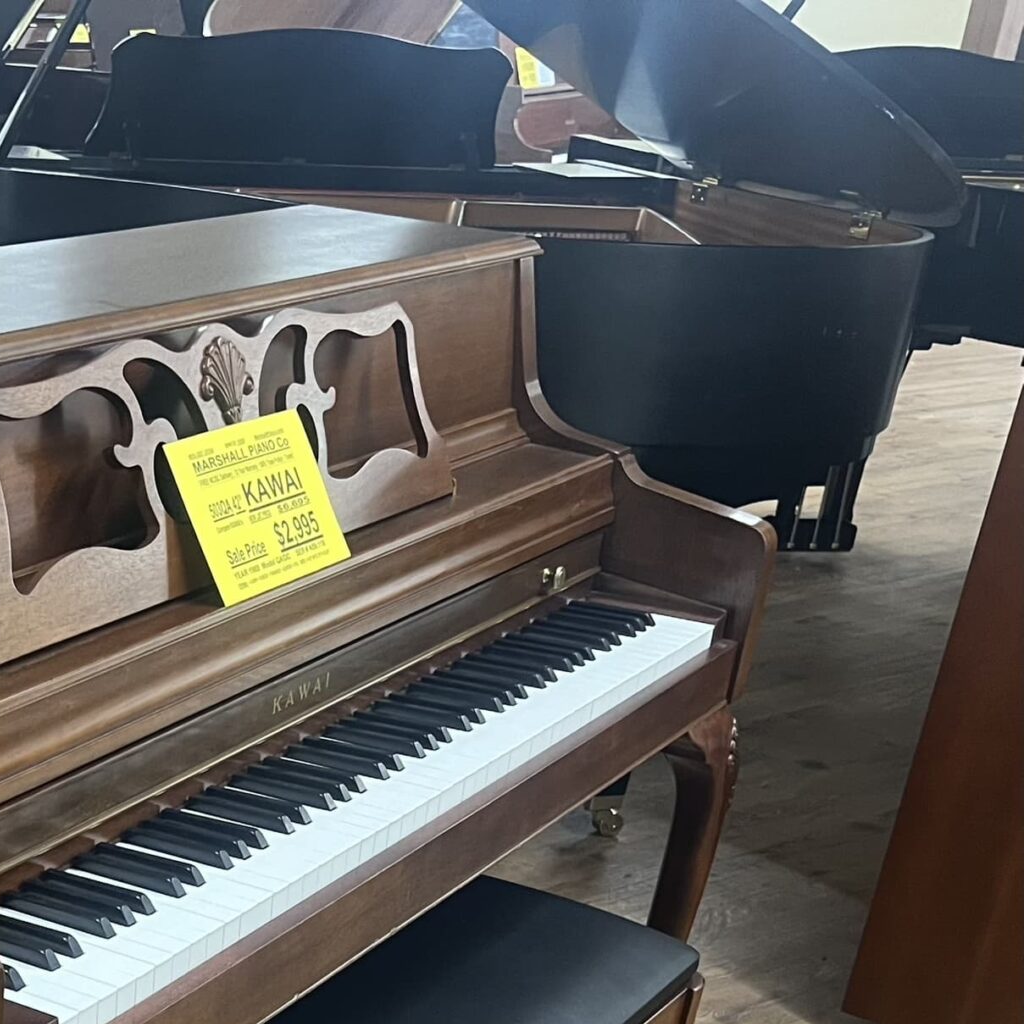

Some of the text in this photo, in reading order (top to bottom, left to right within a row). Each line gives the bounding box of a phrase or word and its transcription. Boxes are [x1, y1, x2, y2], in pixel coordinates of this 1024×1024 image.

[191, 449, 248, 473] MARSHALL
[247, 439, 275, 456] PIANO
[275, 437, 289, 448] Co
[241, 467, 302, 505] KAWAI
[274, 511, 319, 546] $2,995
[225, 547, 245, 564] Sale
[243, 541, 266, 558] Price
[272, 671, 330, 715] KAWAI
